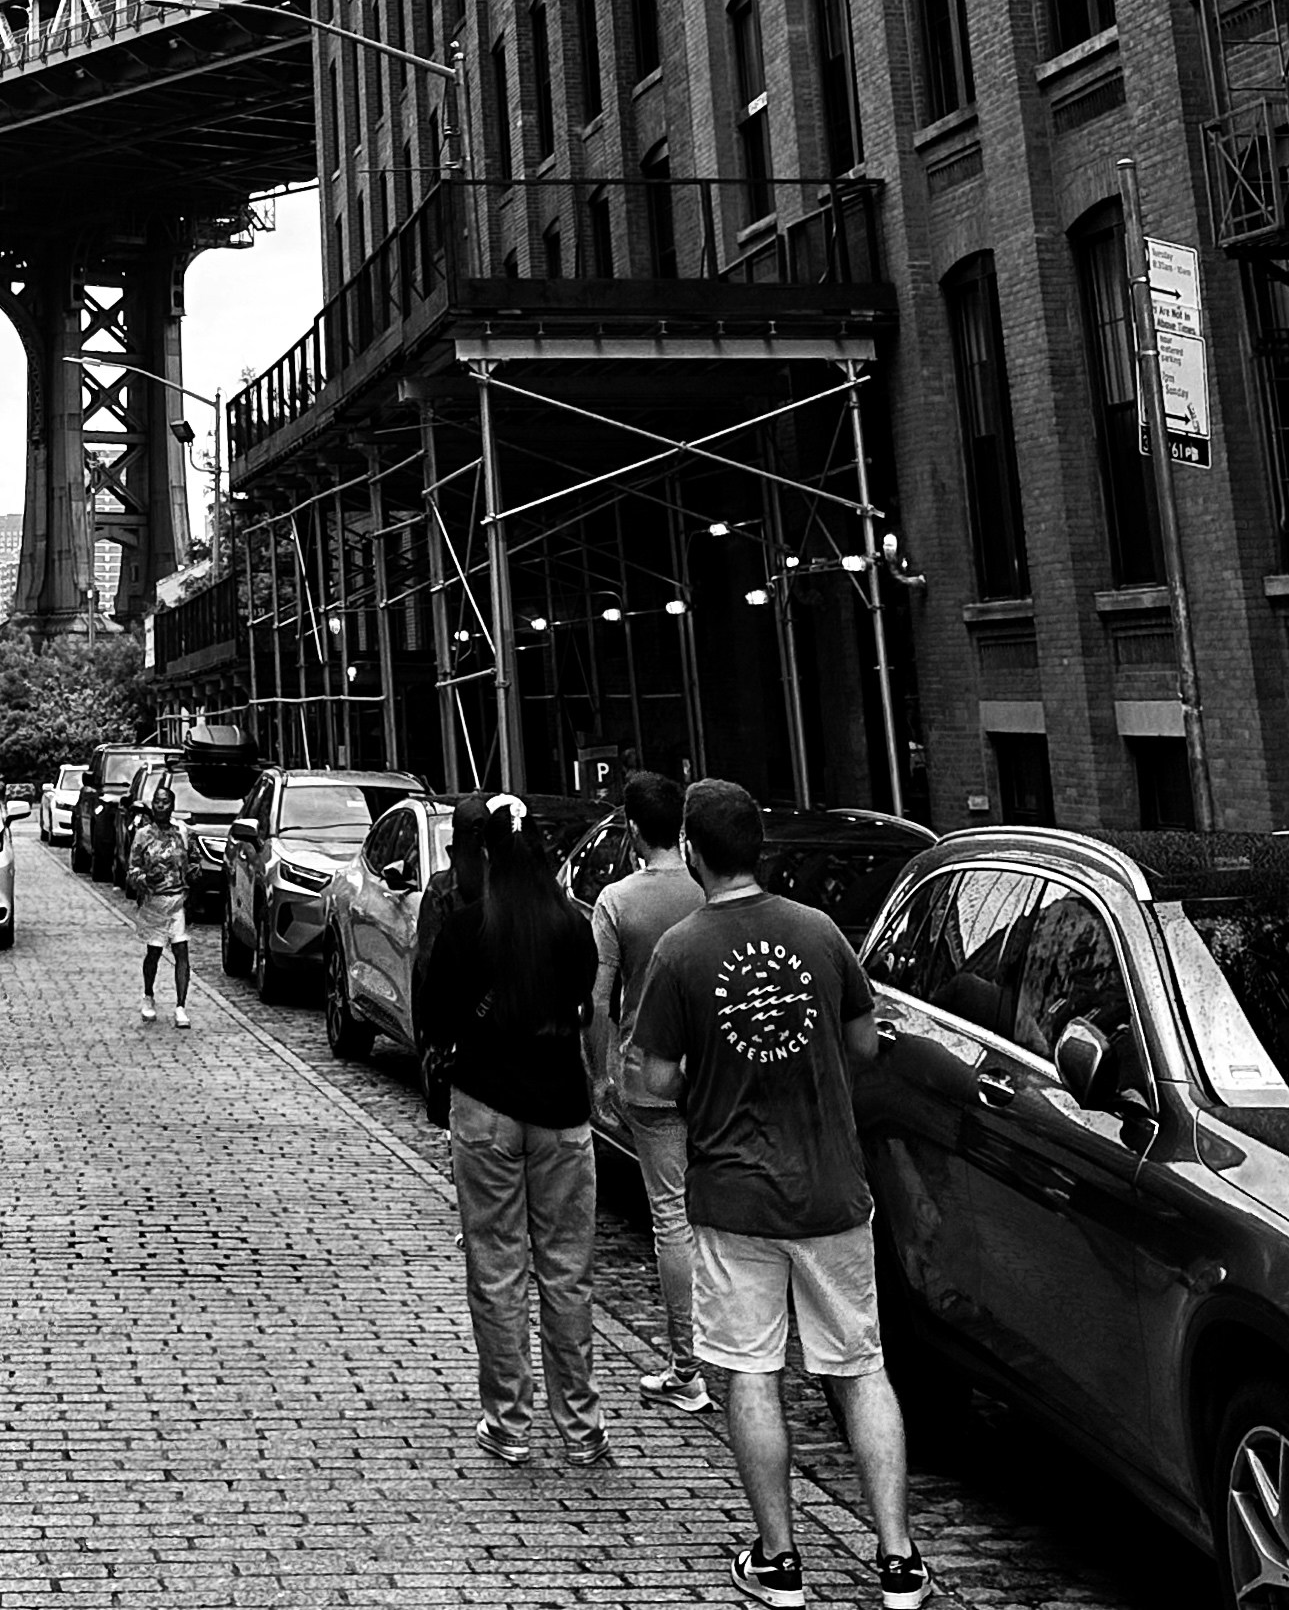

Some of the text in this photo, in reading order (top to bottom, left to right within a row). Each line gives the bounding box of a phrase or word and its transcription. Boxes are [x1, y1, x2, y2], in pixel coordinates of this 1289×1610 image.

[1159, 306, 1170, 317] Are
[1172, 308, 1183, 319] Not
[1185, 311, 1191, 321] In
[1157, 318, 1176, 330] Above
[597, 762, 610, 782] P
[714, 940, 813, 998] BILLABONG
[720, 1021, 757, 1061] FREE
[759, 1032, 809, 1063] SINCE
